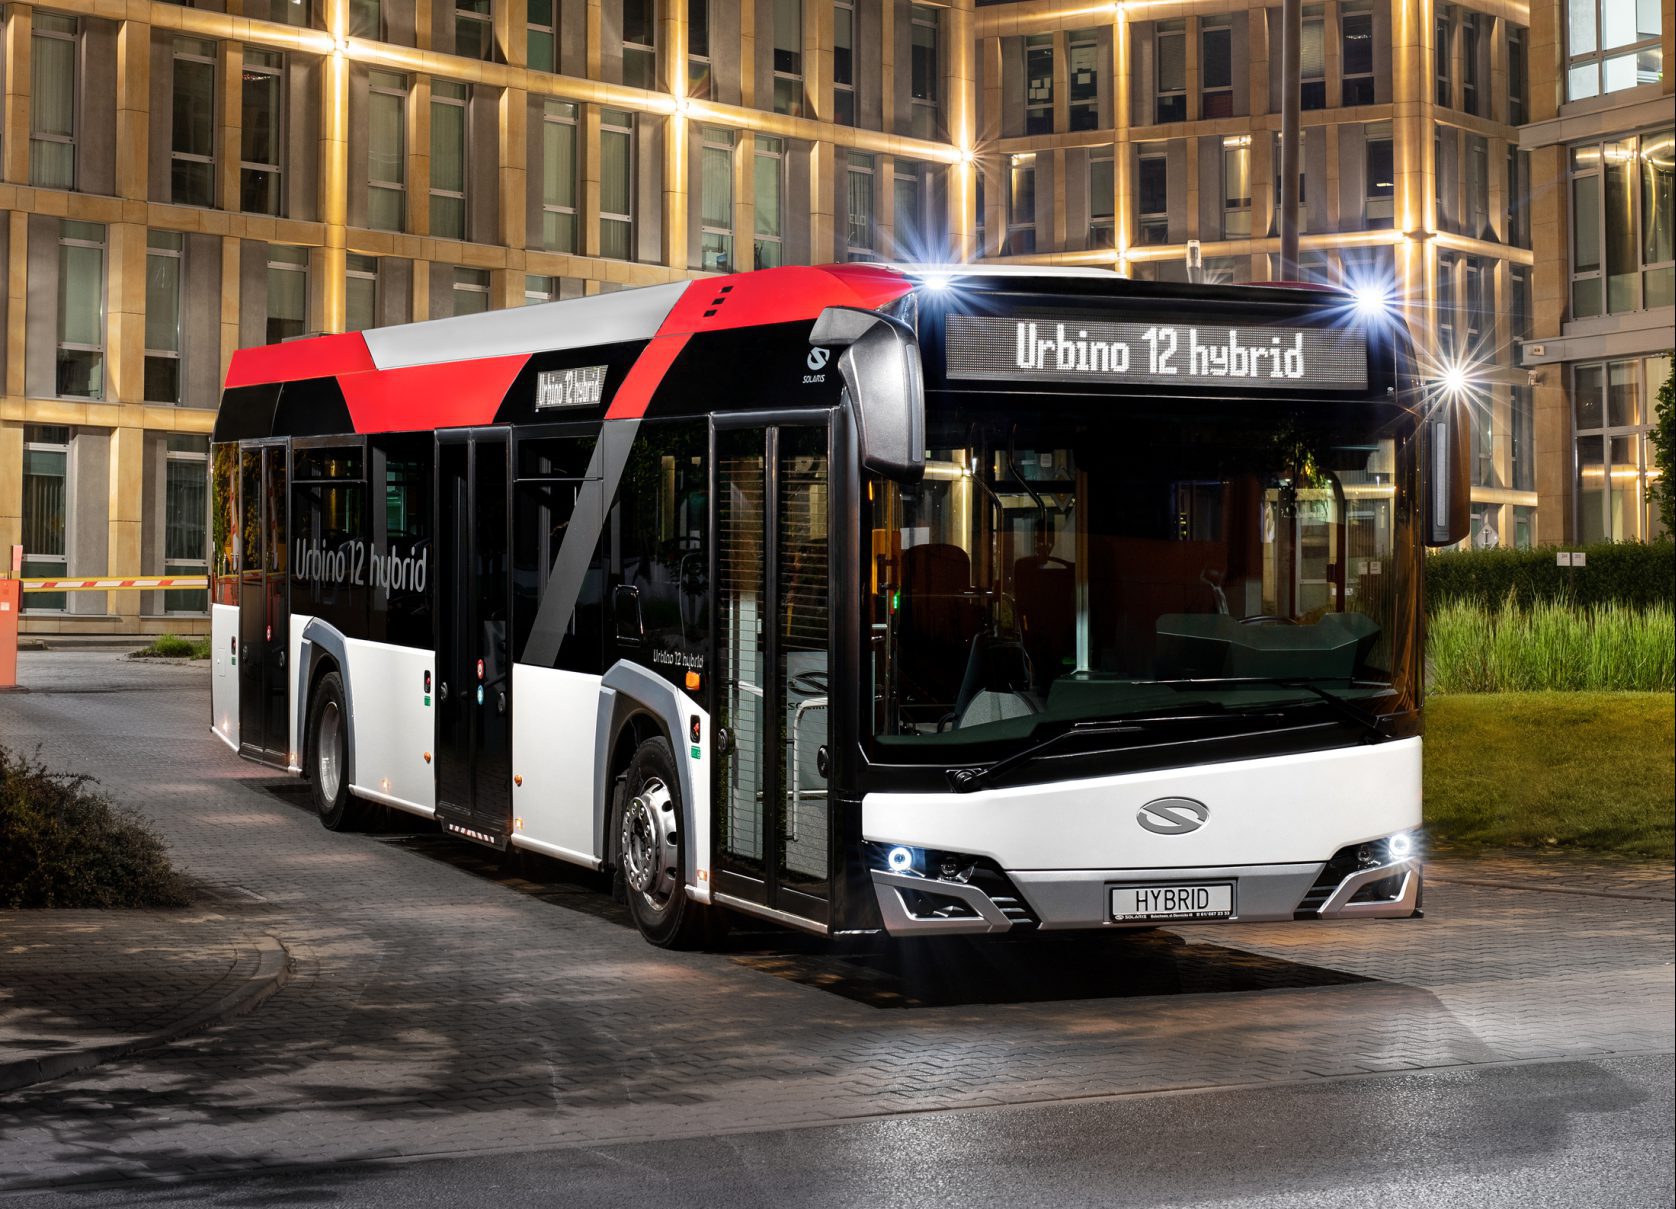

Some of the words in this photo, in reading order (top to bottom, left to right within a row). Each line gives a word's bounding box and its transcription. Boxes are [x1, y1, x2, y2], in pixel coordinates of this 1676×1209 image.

[1016, 323, 1130, 371] Urbino
[1141, 327, 1179, 374] 12
[1190, 330, 1304, 378] hybrid
[539, 373, 563, 405] Urbino
[565, 370, 574, 404] 12
[802, 374, 826, 384] SOLARIS
[295, 537, 346, 583] Urbino
[347, 540, 365, 586] 12
[369, 542, 427, 600] hybrid
[653, 649, 674, 665] Urbino
[674, 651, 682, 666] 12
[682, 652, 704, 670] hybrid
[1135, 888, 1209, 912] HYBRID
